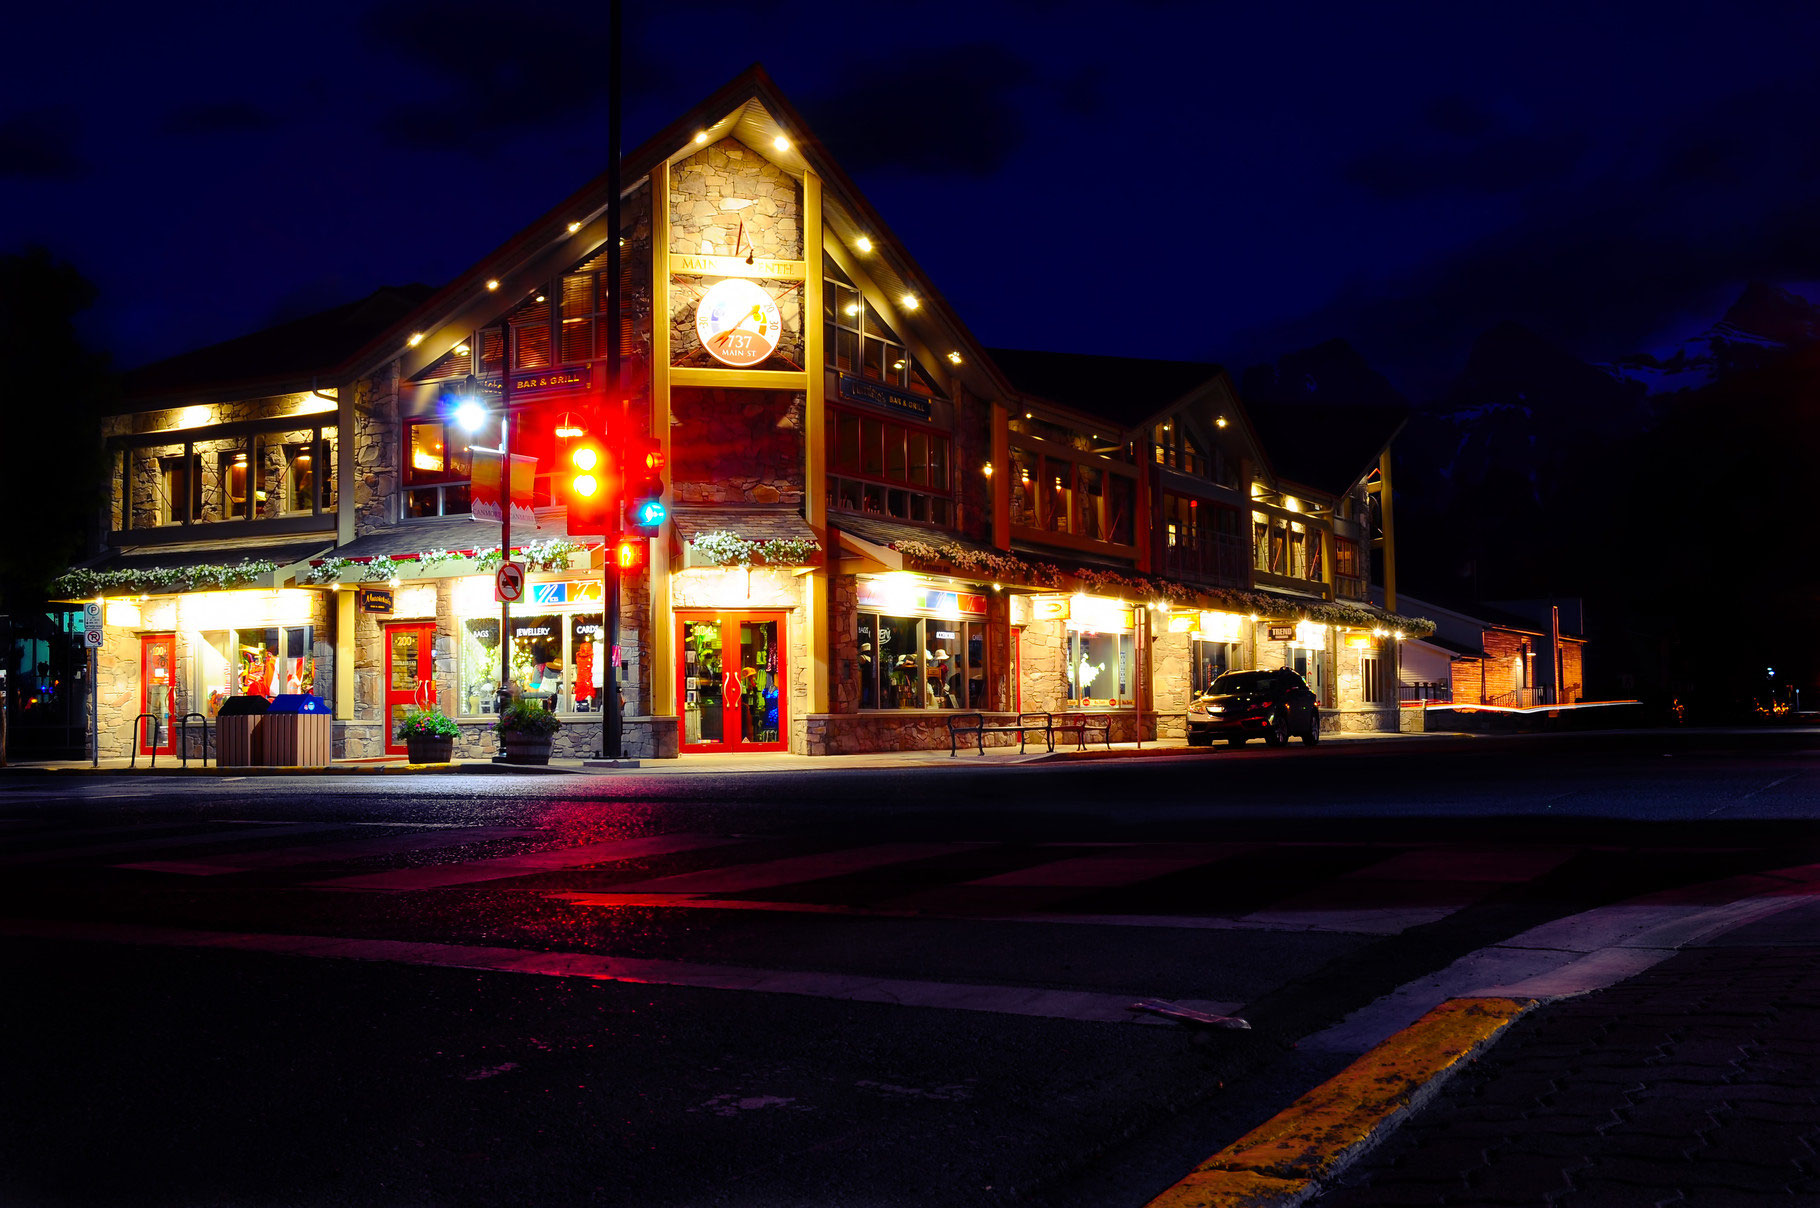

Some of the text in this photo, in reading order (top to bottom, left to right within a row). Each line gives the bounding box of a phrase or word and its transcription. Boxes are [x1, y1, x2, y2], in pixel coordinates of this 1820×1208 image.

[682, 258, 717, 270] MAIN
[727, 334, 752, 348] 737
[516, 374, 580, 389] BAR & GRILL
[473, 629, 489, 638] BAGS
[516, 627, 551, 637] JEWELLERY
[576, 624, 600, 634] CARDS
[694, 625, 713, 635] 104
[1272, 628, 1292, 636] TREND
[397, 636, 412, 646] 200
